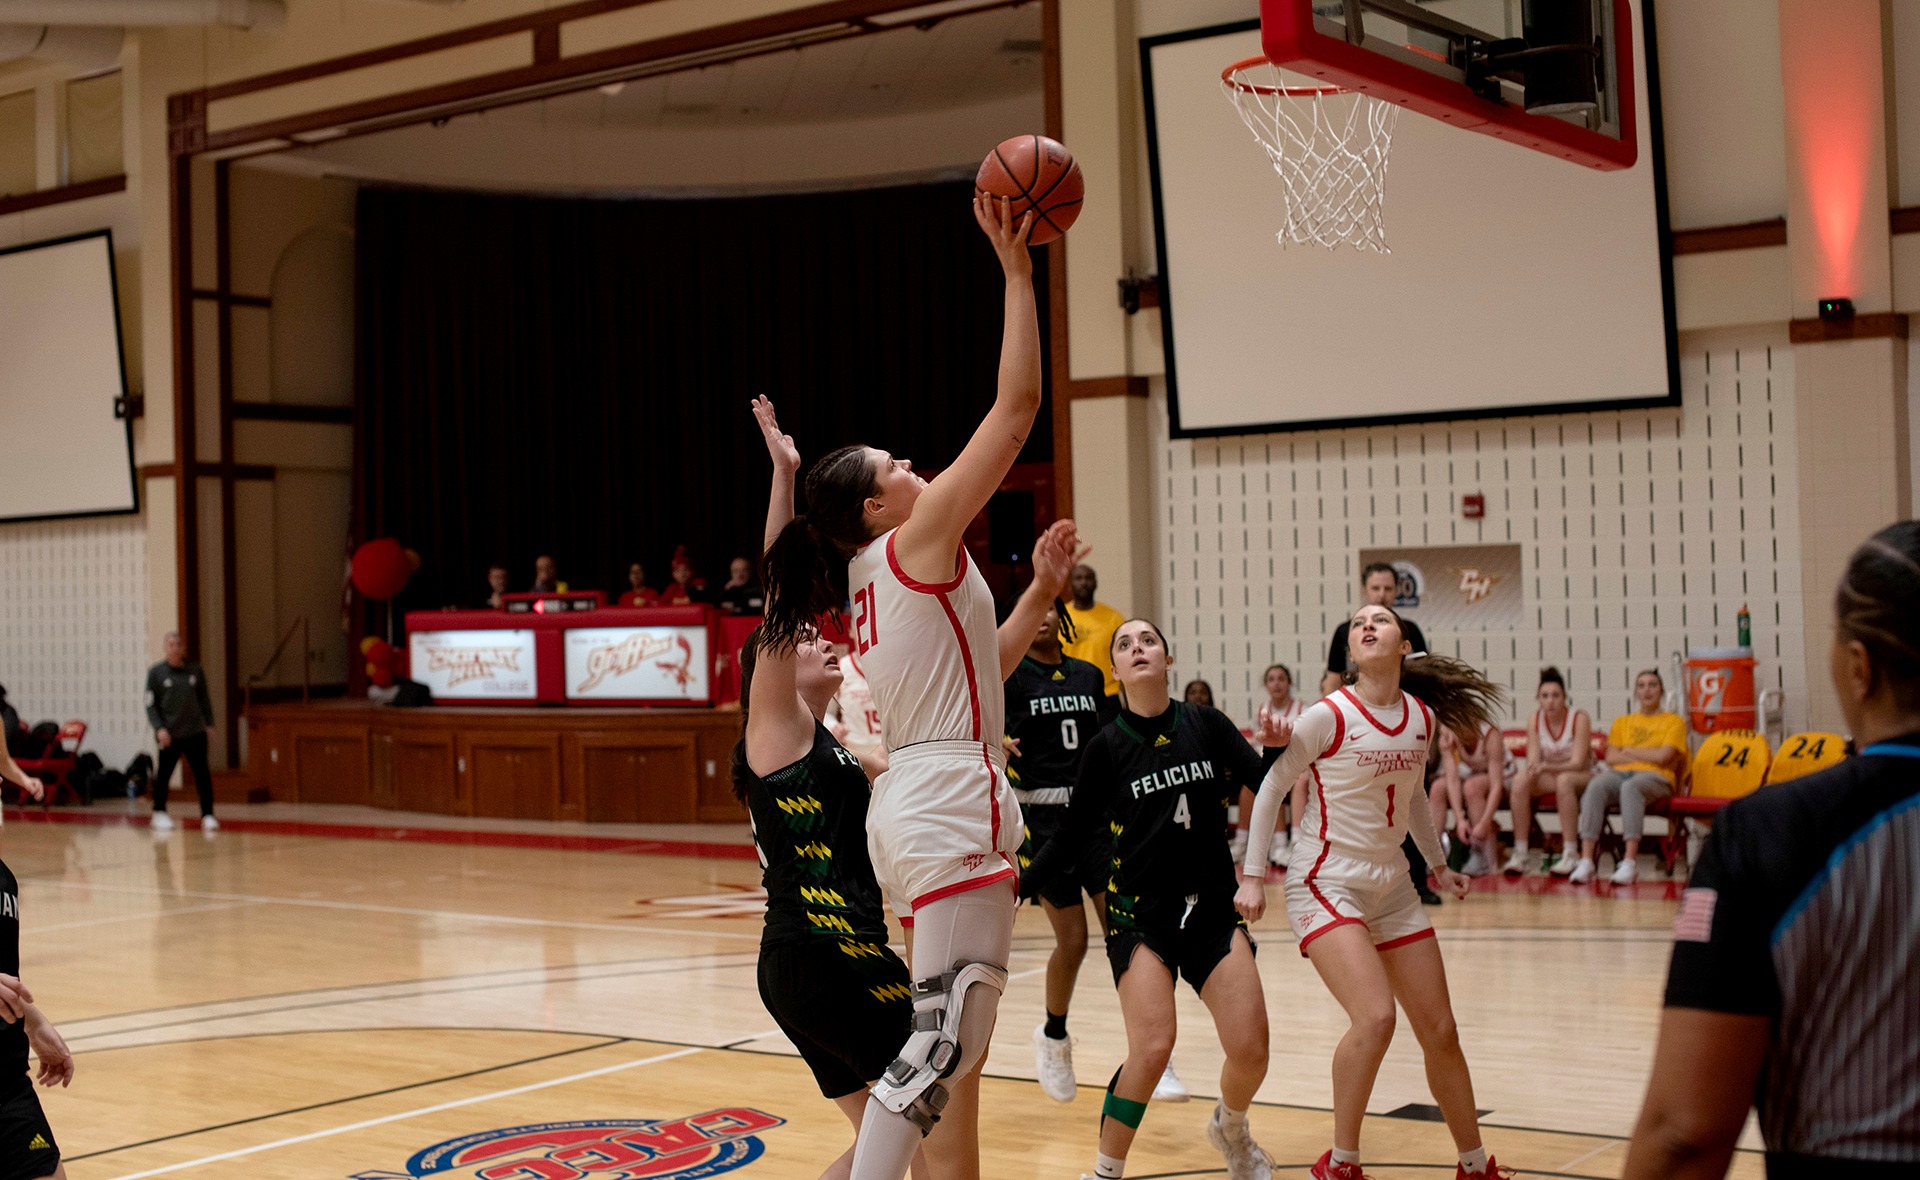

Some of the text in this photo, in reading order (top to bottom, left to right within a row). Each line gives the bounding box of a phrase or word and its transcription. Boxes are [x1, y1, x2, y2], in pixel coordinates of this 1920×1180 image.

[854, 581, 878, 657] 21
[1700, 671, 1719, 694] G
[1030, 695, 1096, 716] FELICIAN
[1061, 718, 1079, 750] 0
[1789, 736, 1826, 761] 24
[1715, 744, 1750, 769] 24
[1130, 760, 1214, 800] FELICIAN
[1173, 793, 1191, 830] 4
[1386, 784, 1396, 827] 1
